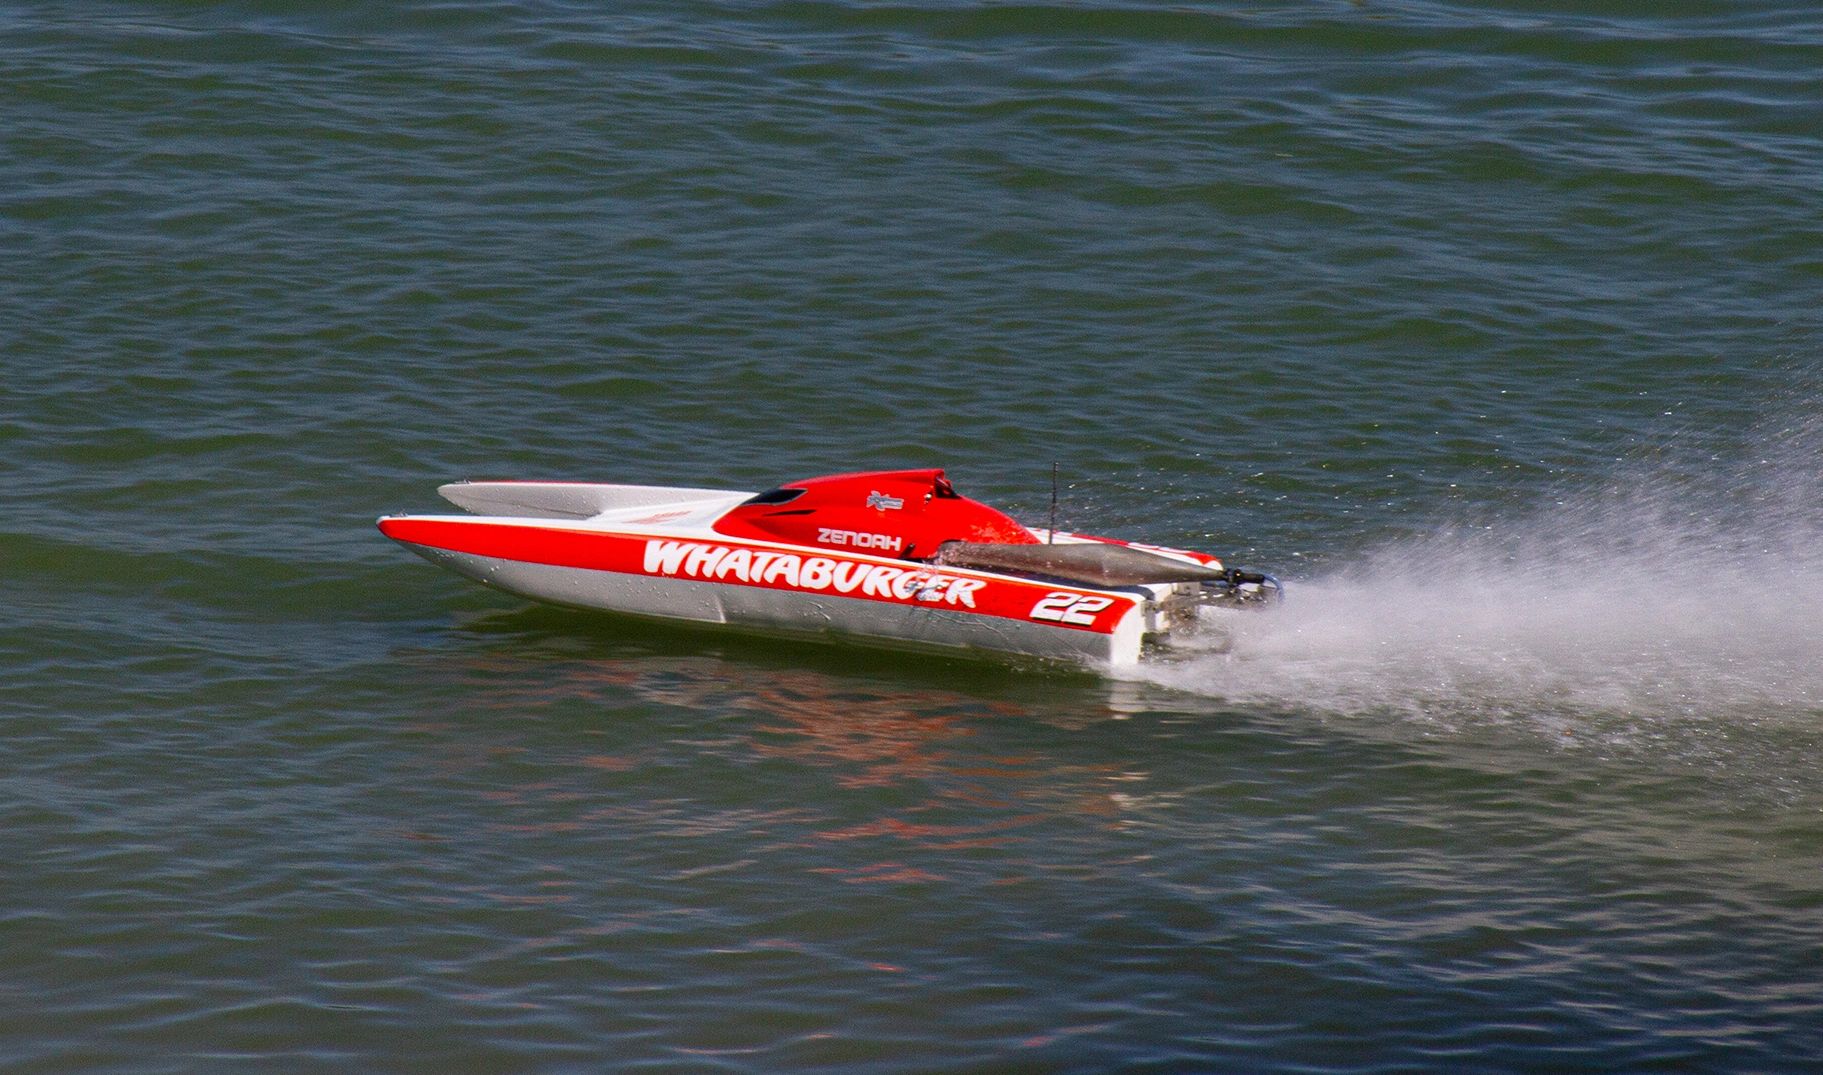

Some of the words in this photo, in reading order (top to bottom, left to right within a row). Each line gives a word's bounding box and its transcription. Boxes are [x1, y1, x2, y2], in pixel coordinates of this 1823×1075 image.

[817, 527, 902, 551] ZENOAH
[643, 539, 987, 609] WHATABURGER
[1029, 591, 1115, 626] 22
